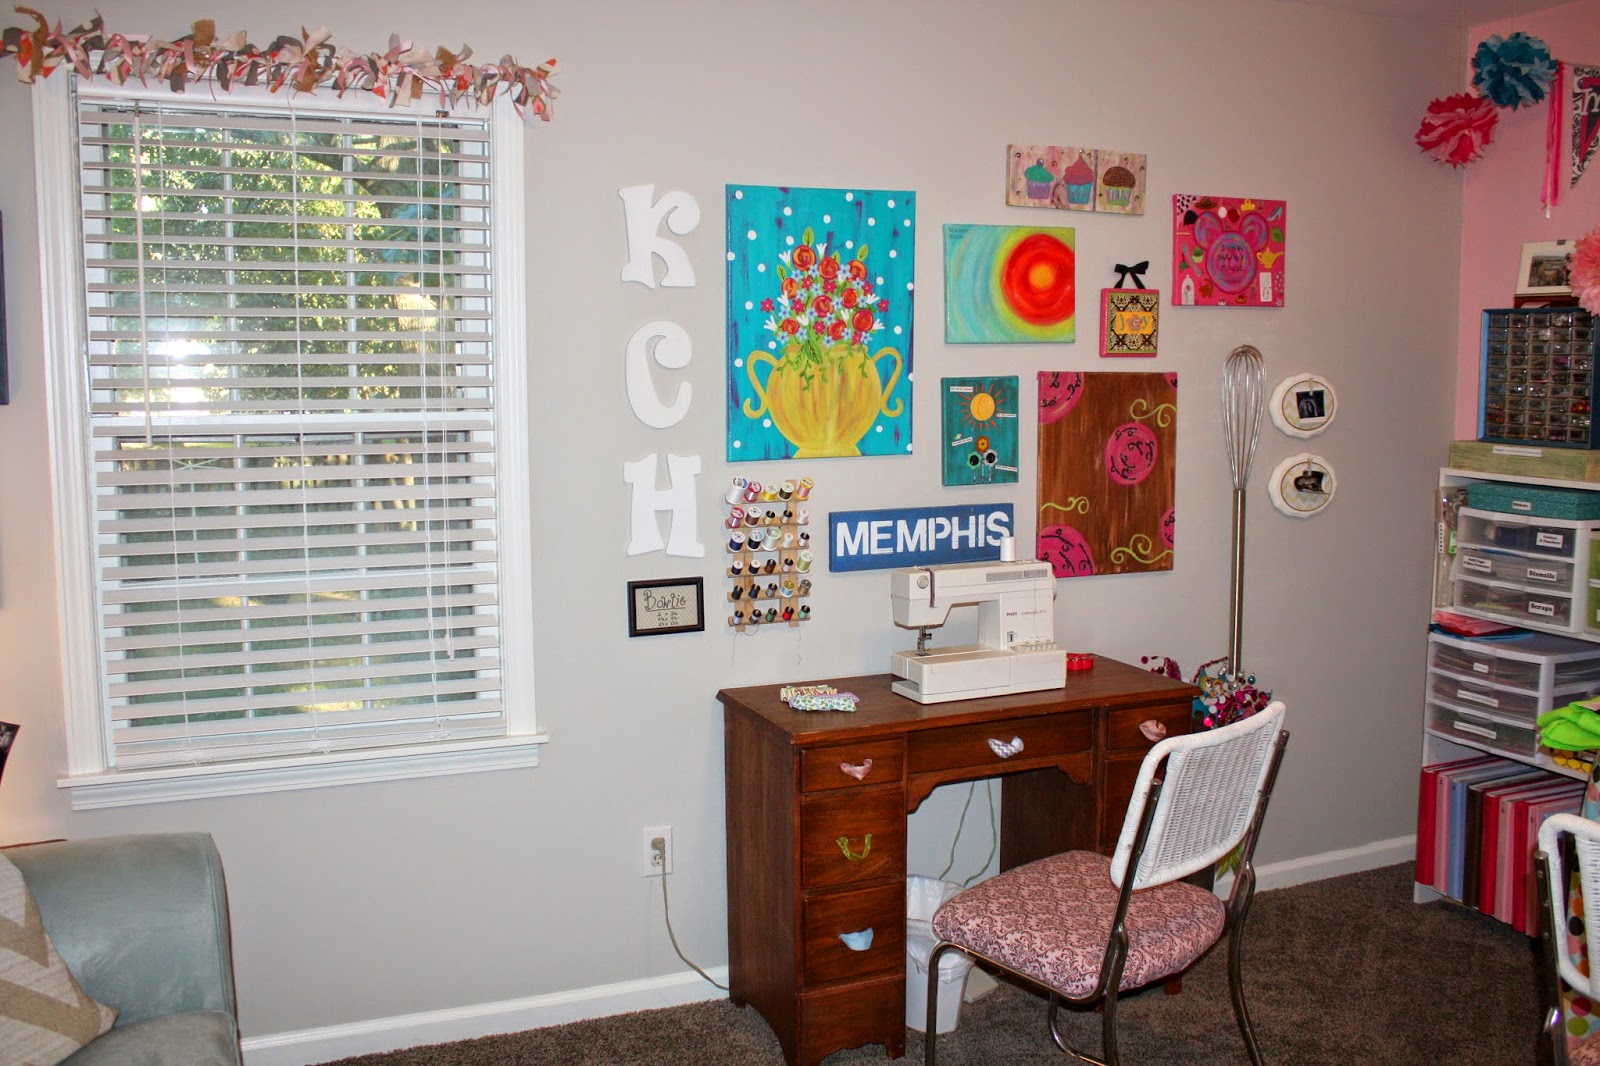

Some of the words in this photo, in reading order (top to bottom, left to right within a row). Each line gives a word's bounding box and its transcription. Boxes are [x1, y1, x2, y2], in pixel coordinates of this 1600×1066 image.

[618, 184, 700, 289] K
[625, 320, 692, 428] C
[623, 452, 705, 557] H
[836, 510, 1011, 557] MEMPHIS
[1528, 570, 1555, 579] Stencils
[643, 590, 686, 610] Bowtie
[1530, 603, 1553, 612] Scraps
